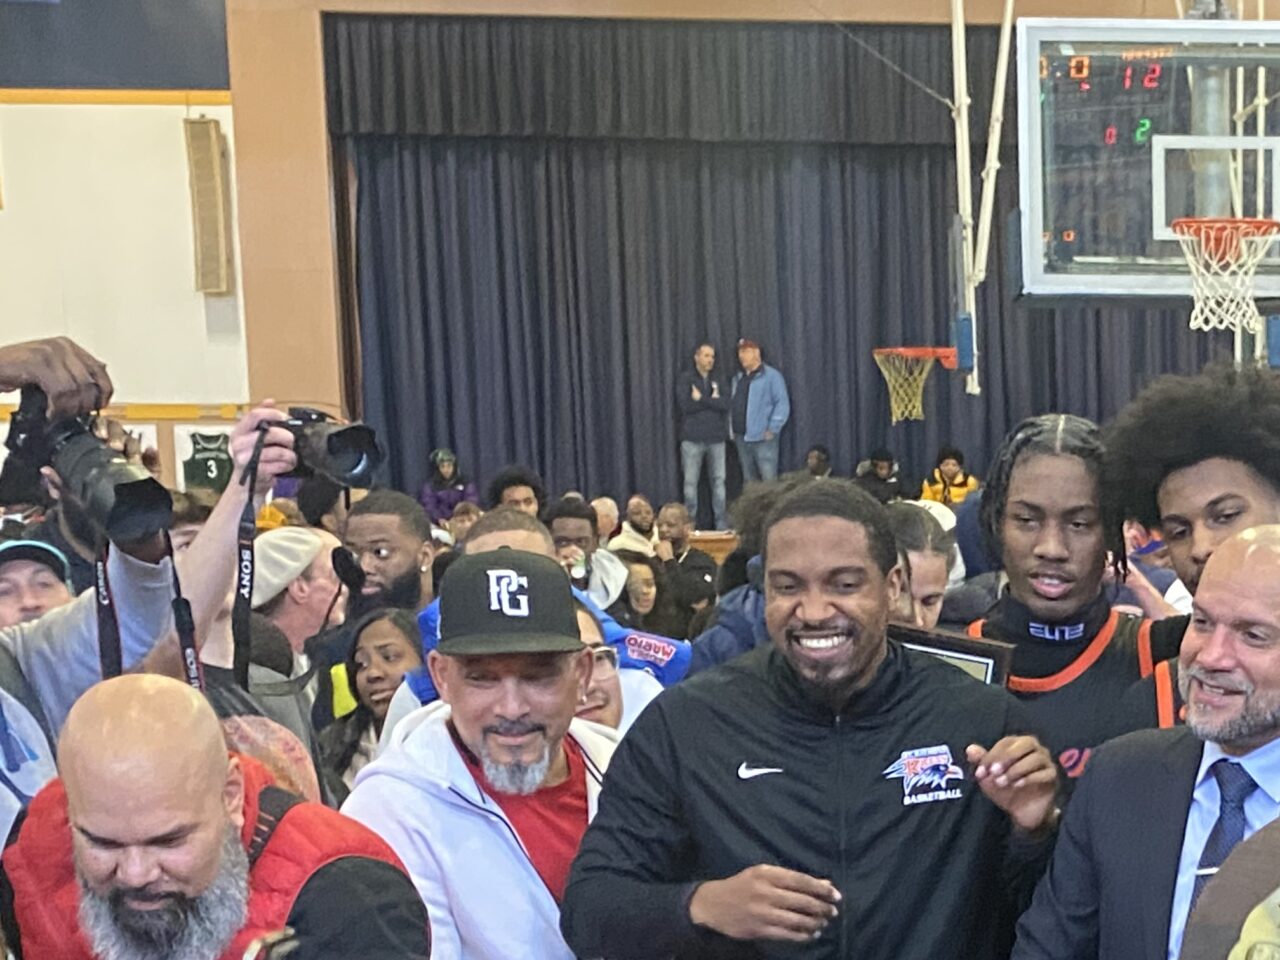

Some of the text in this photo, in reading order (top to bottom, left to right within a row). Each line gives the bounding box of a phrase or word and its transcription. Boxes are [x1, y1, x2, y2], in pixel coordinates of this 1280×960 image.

[207, 459, 218, 479] 3
[239, 550, 252, 598] SONY
[486, 569, 529, 616] PG
[627, 636, 676, 660] MARIO
[903, 788, 963, 806] BASKETBALL
